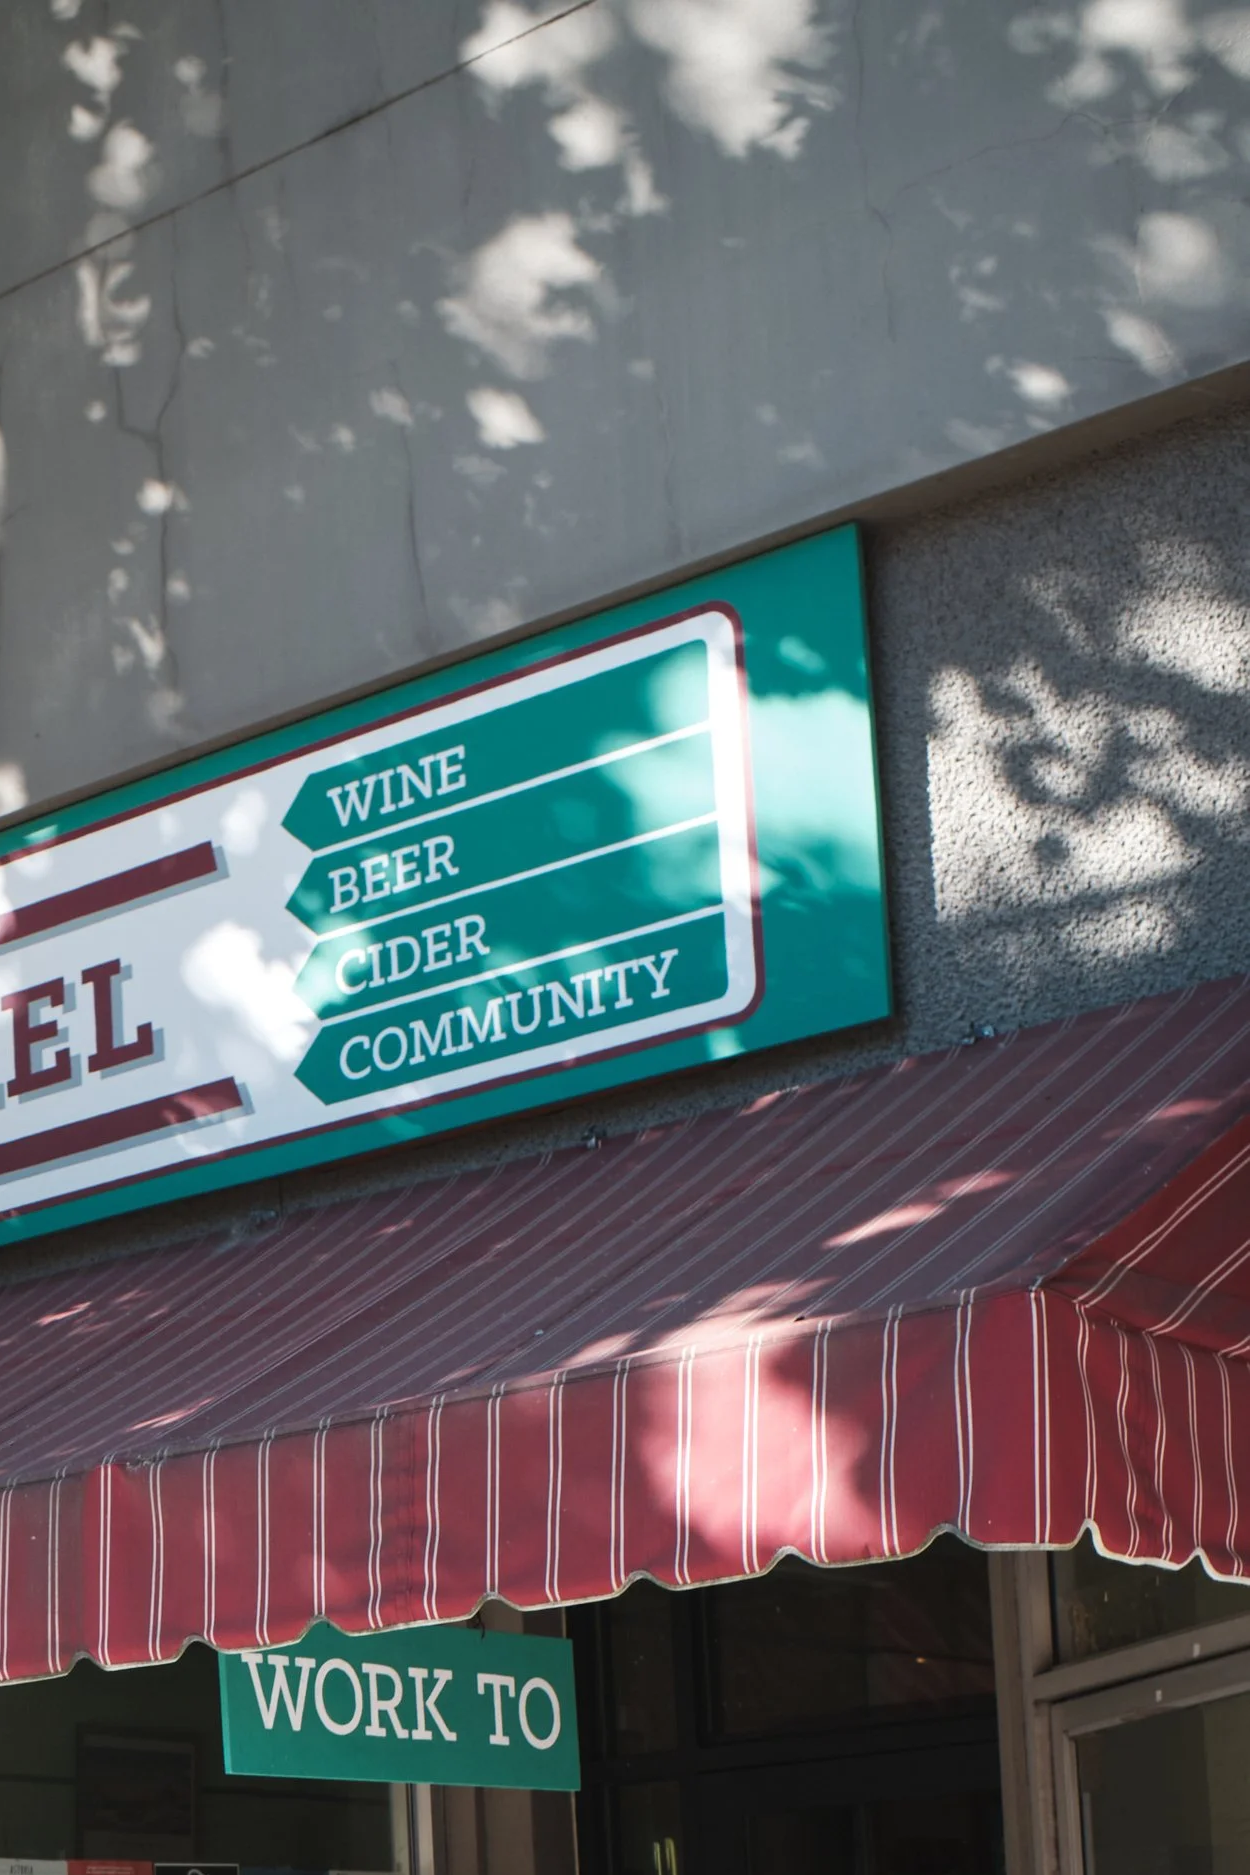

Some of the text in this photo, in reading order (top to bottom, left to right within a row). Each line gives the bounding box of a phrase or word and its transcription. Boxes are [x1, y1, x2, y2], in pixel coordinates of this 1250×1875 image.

[327, 745, 468, 828] WINE
[327, 834, 460, 914] BEER
[334, 914, 491, 996] CIDER
[338, 949, 679, 1082] COMMUNITY
[241, 1652, 561, 1750] WORK TO
